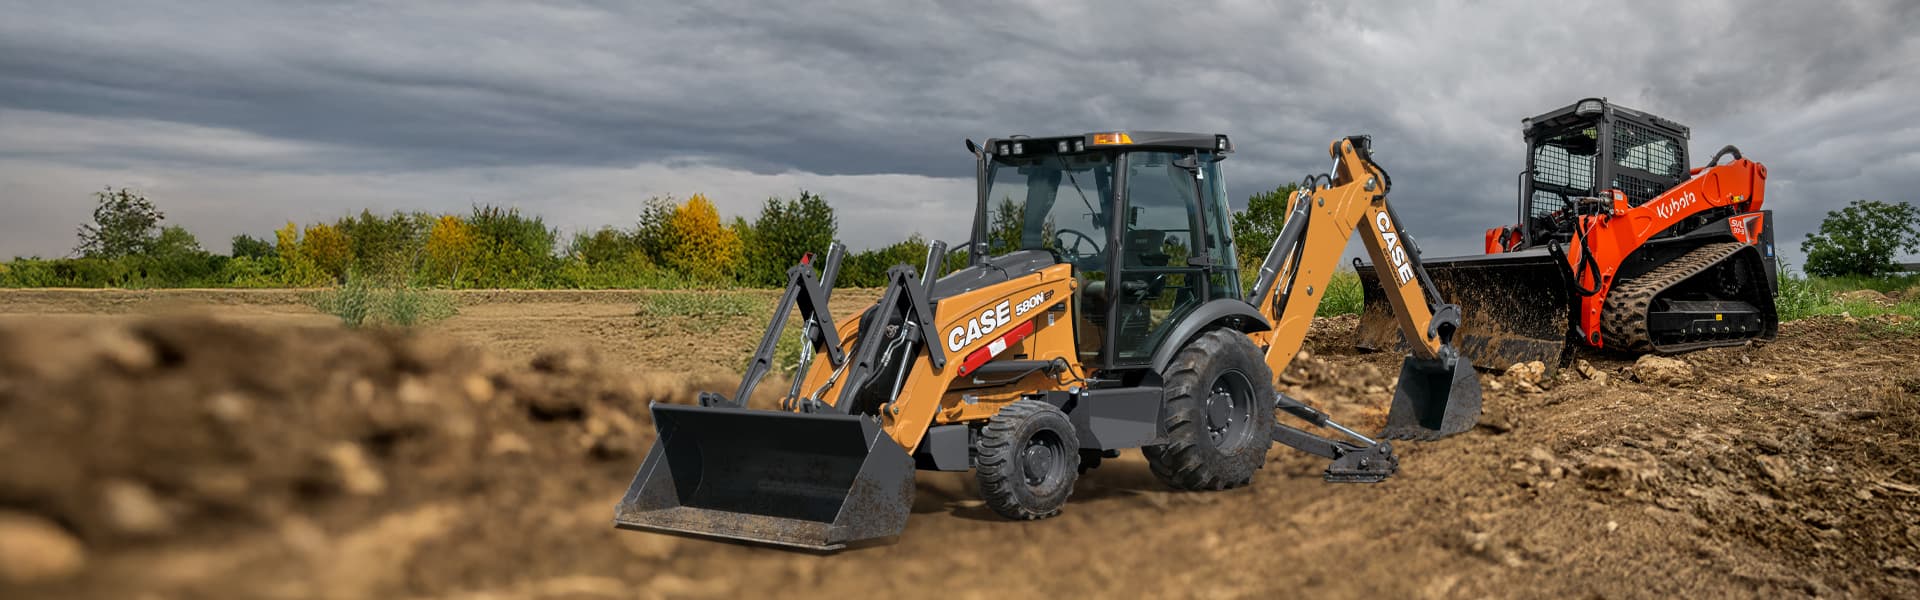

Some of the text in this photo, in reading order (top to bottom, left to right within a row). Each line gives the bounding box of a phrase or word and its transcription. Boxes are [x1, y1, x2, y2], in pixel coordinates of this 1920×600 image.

[1656, 191, 1696, 219] Kubota
[1376, 211, 1414, 285] CASE
[948, 299, 1011, 352] CASE
